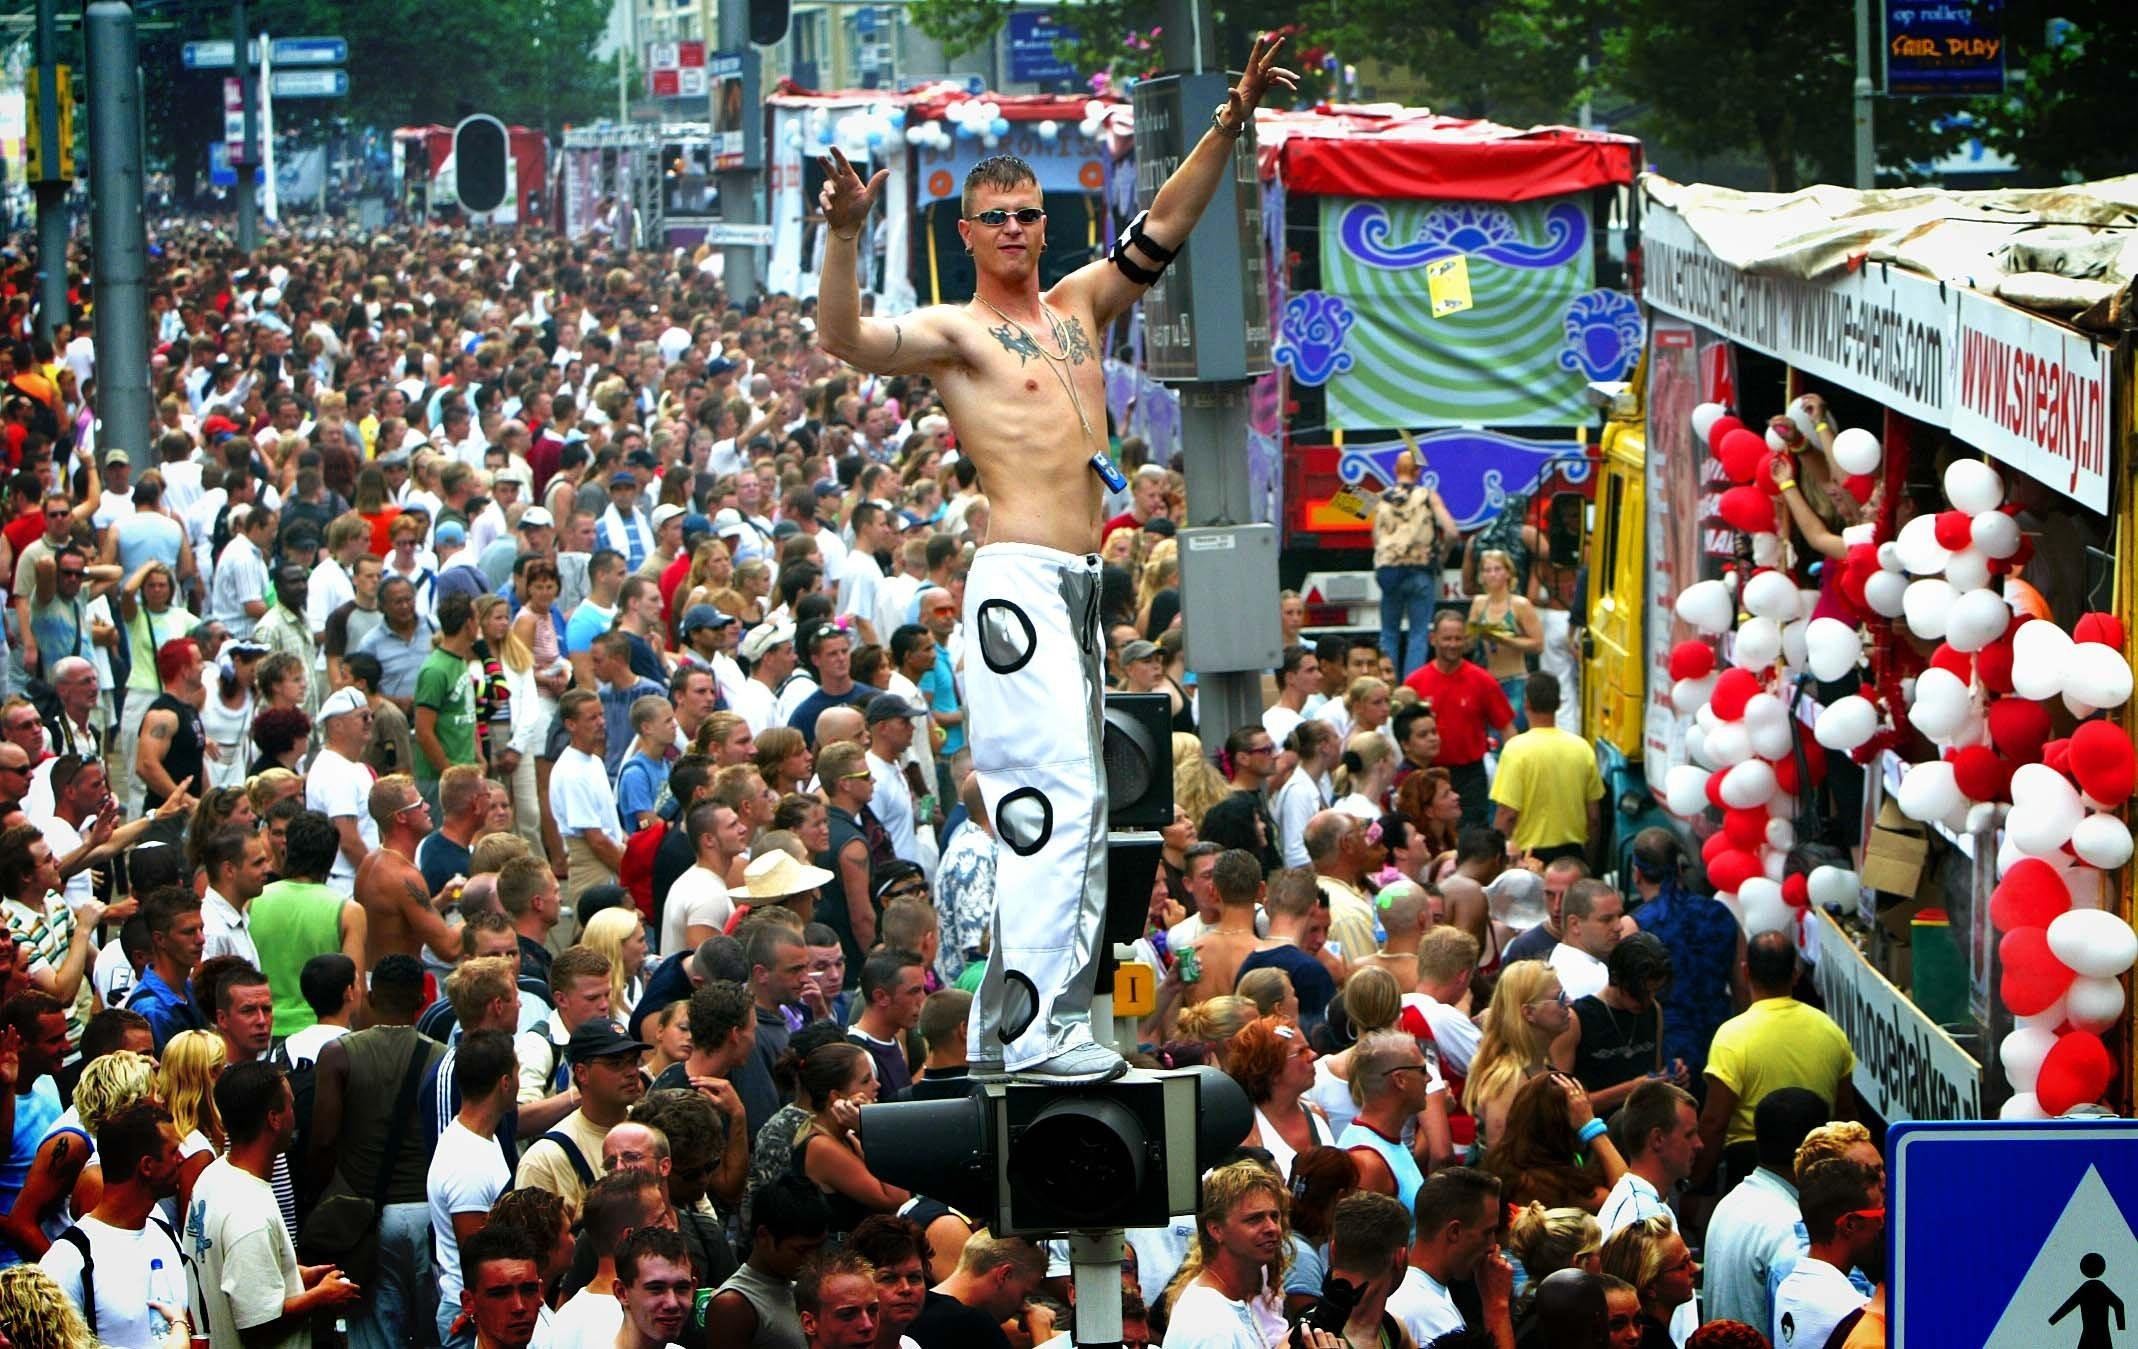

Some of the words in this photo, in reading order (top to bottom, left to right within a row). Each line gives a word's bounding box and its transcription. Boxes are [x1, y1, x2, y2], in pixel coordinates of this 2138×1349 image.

[1891, 35, 1942, 56] FAIR
[1946, 38, 2000, 60] PLAY
[1962, 324, 2105, 493] www.sneaky.nl
[1820, 942, 1982, 1120] www.hogehakken
